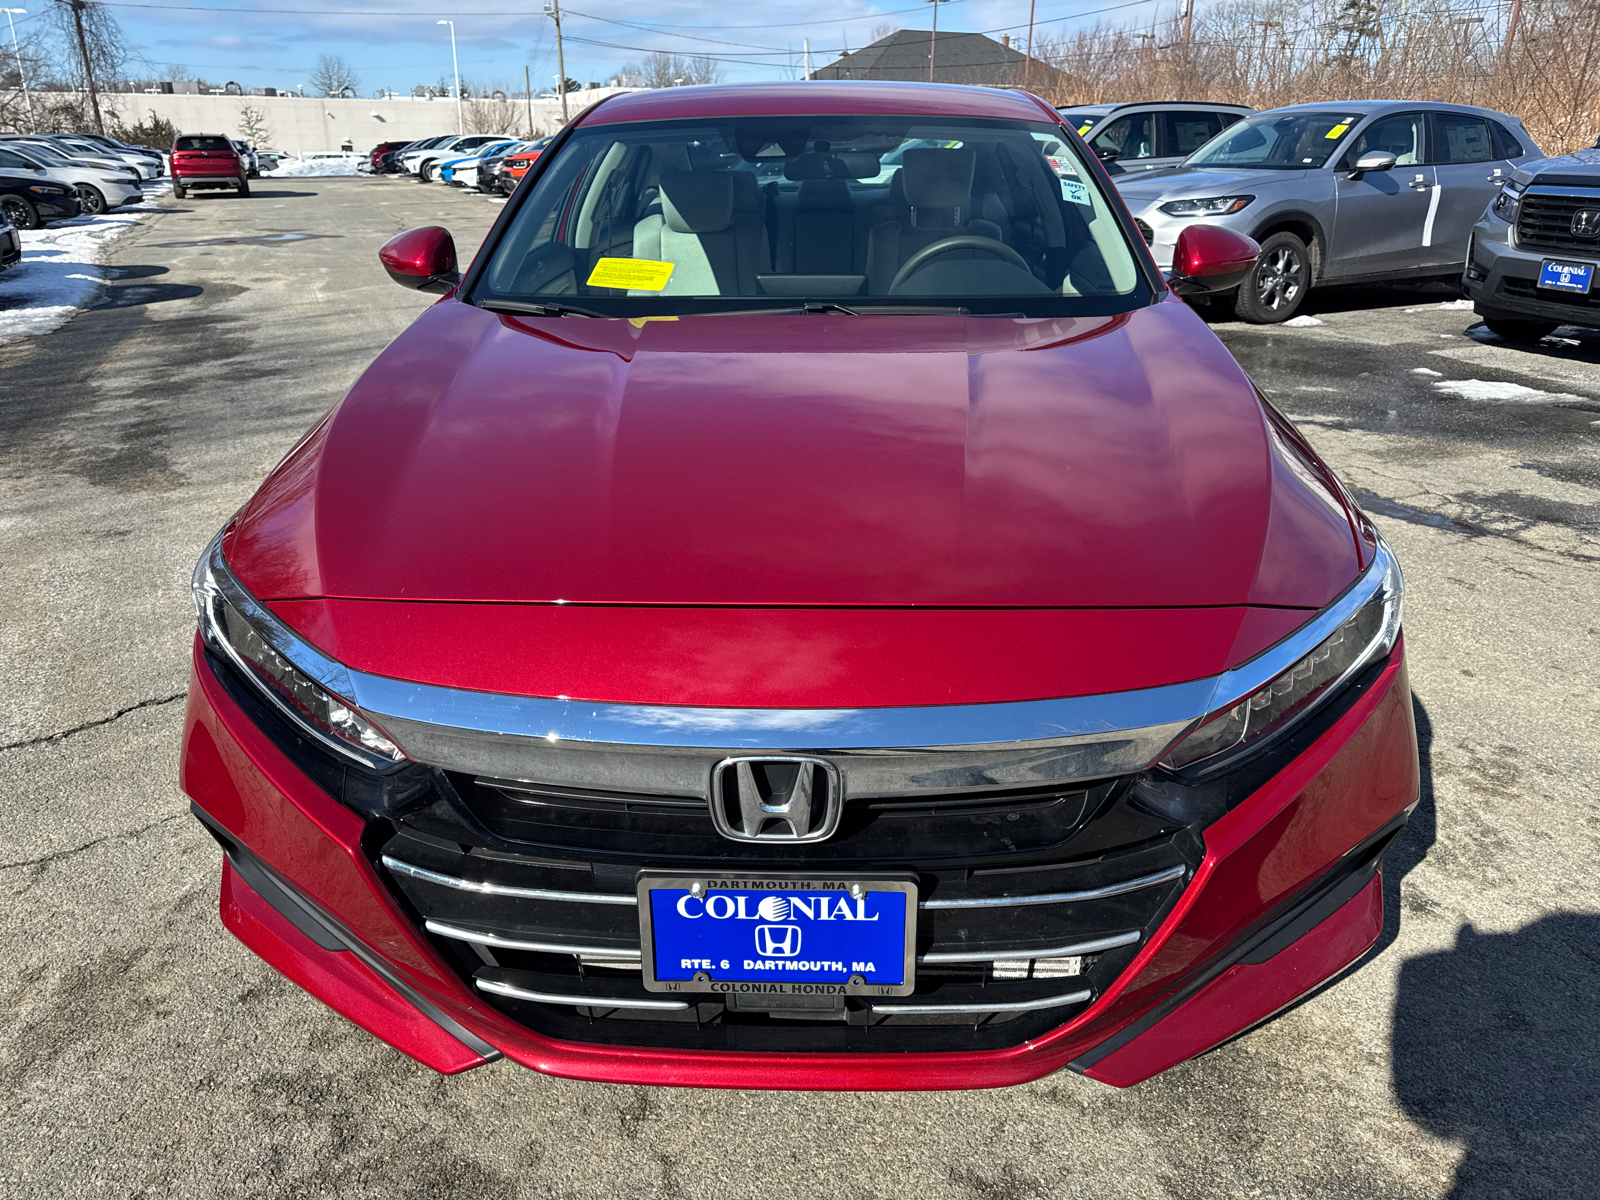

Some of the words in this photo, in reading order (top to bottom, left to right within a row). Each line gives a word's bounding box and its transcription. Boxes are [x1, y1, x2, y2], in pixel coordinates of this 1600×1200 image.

[1063, 182, 1085, 190] SAFETY
[1547, 263, 1587, 275] COLONIAL
[822, 882, 847, 891] MA
[676, 895, 878, 921] COLONIAL
[681, 959, 716, 969] RTE.
[720, 960, 730, 970] 6
[743, 960, 848, 973] DARTMOUTH,
[852, 962, 876, 973] MA
[710, 982, 786, 993] COLONIAL
[791, 983, 847, 995] HONDA
